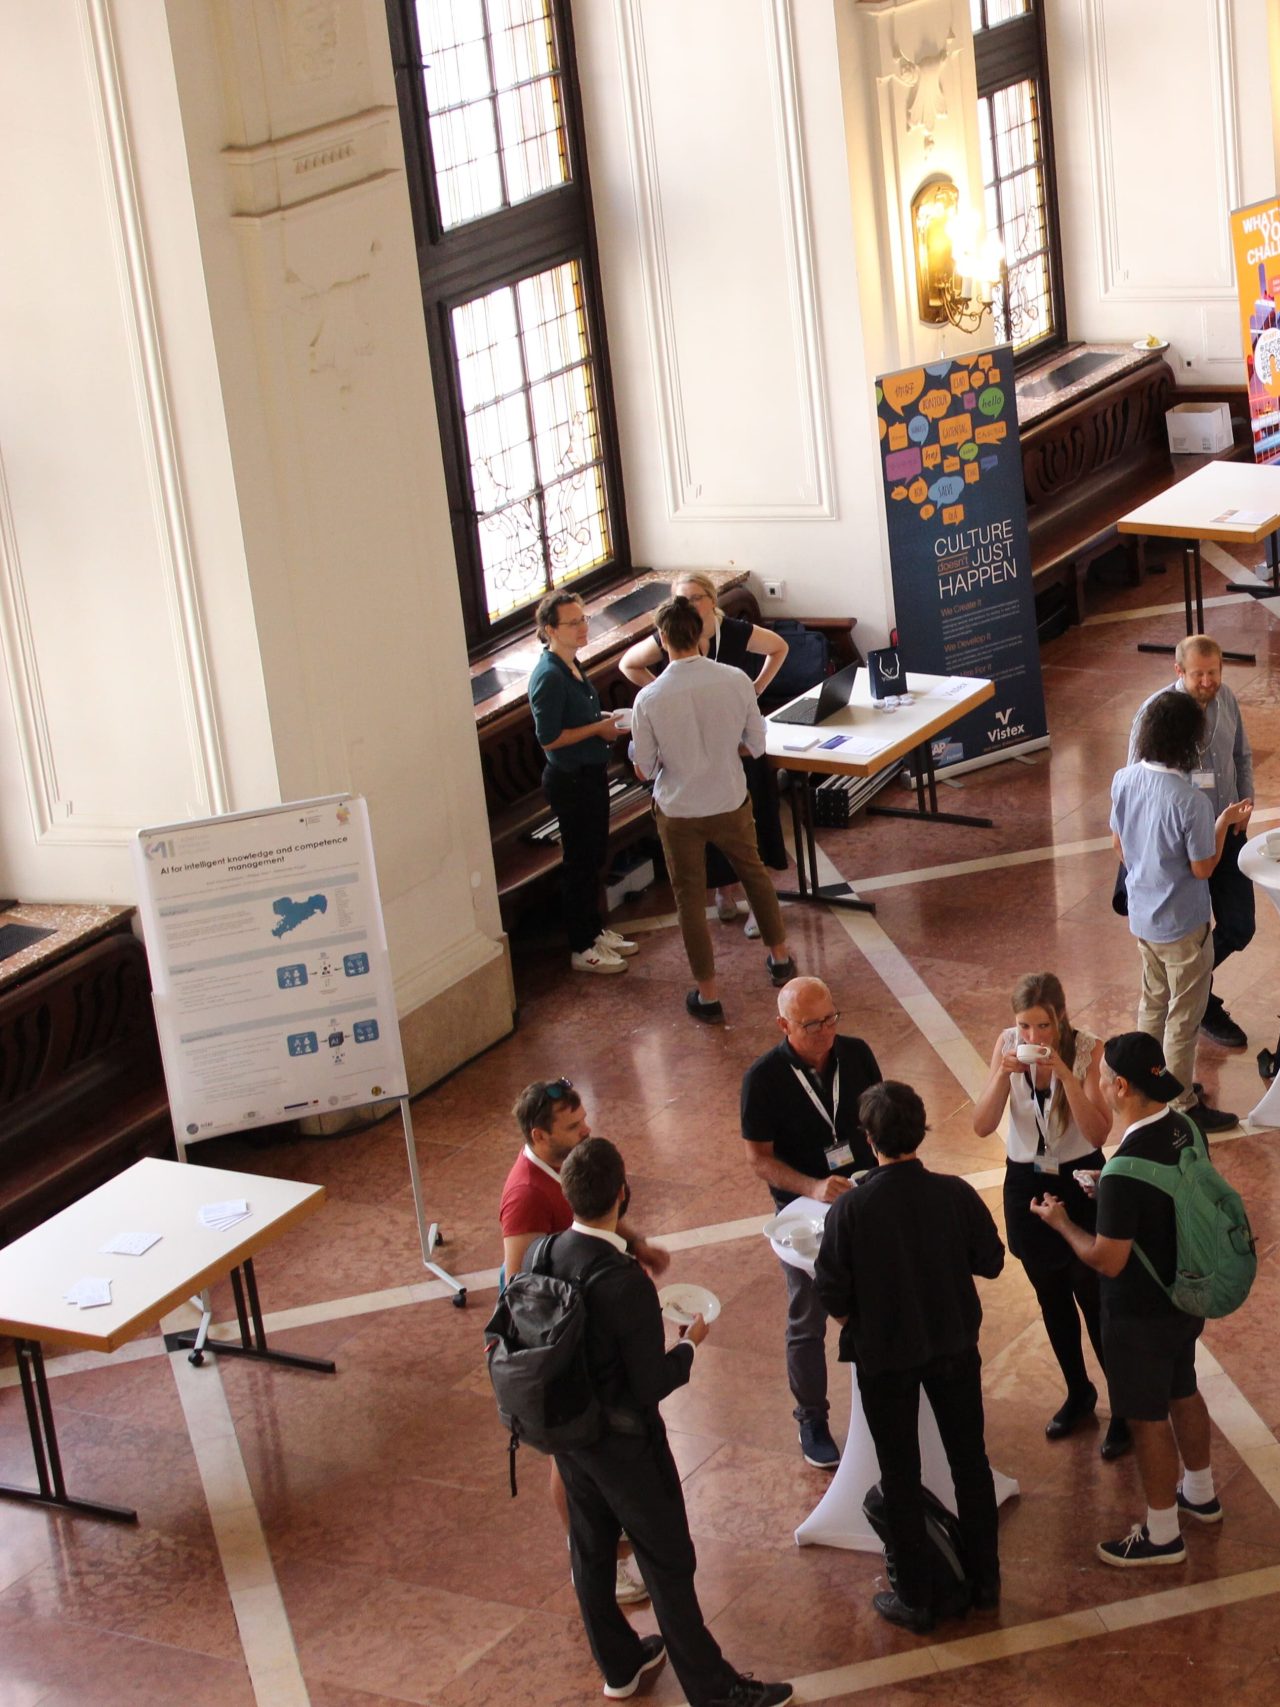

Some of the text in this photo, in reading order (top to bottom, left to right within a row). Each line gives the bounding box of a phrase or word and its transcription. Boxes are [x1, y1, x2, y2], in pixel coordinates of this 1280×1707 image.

[982, 396, 1002, 408] hello
[925, 450, 939, 461] hej
[934, 519, 1014, 557] CULTURE
[938, 539, 1014, 573] doesn't JUST
[938, 558, 1018, 600] HAPPEN
[941, 607, 953, 617] We
[953, 601, 977, 614] Create
[944, 642, 957, 652] We
[957, 635, 986, 649] Develop
[987, 724, 1025, 742] Vistex
[931, 742, 946, 756] AP
[160, 836, 348, 875] AI for intelligent knowledge and competence
[228, 856, 285, 872] management
